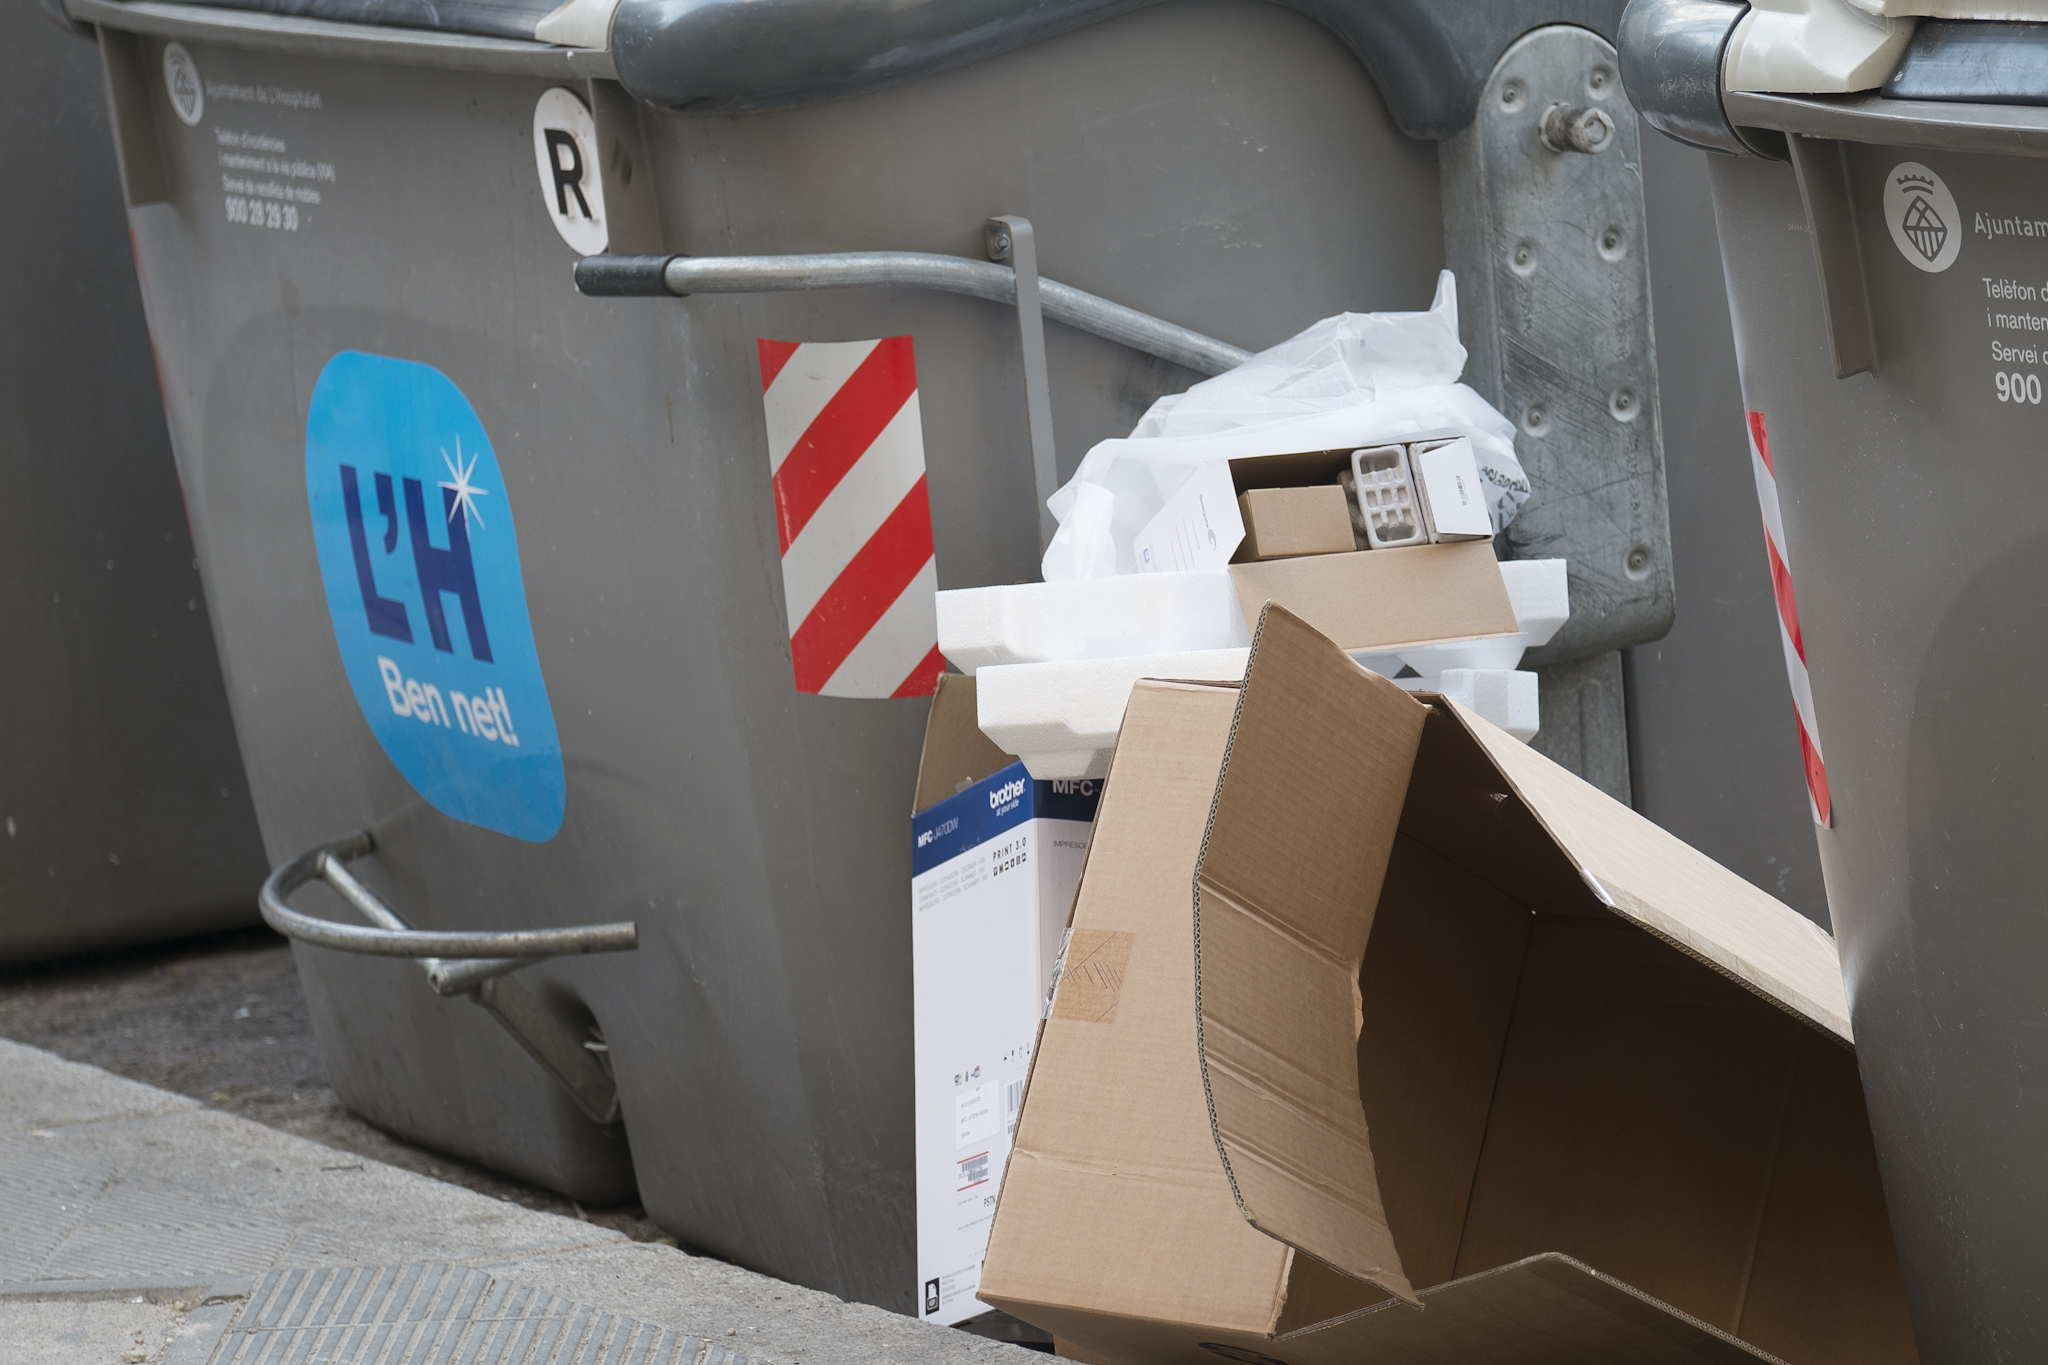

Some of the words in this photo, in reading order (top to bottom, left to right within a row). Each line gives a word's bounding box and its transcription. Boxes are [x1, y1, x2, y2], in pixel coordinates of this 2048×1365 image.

[544, 128, 592, 220] R
[225, 195, 249, 224] 900
[248, 198, 265, 227] 28
[265, 201, 281, 230] 29
[282, 204, 299, 232] 30
[1982, 277, 2036, 301] Telèfon
[1986, 307, 1992, 328] i
[1996, 312, 2048, 331] manten
[1991, 340, 2038, 364] Servei
[1995, 371, 2042, 405] 900
[340, 463, 494, 664] L'H
[377, 654, 452, 729] Ben
[449, 685, 520, 747] net!
[989, 777, 1026, 809] brother
[992, 843, 1012, 862] PRINT
[1015, 836, 1027, 851] 3.0
